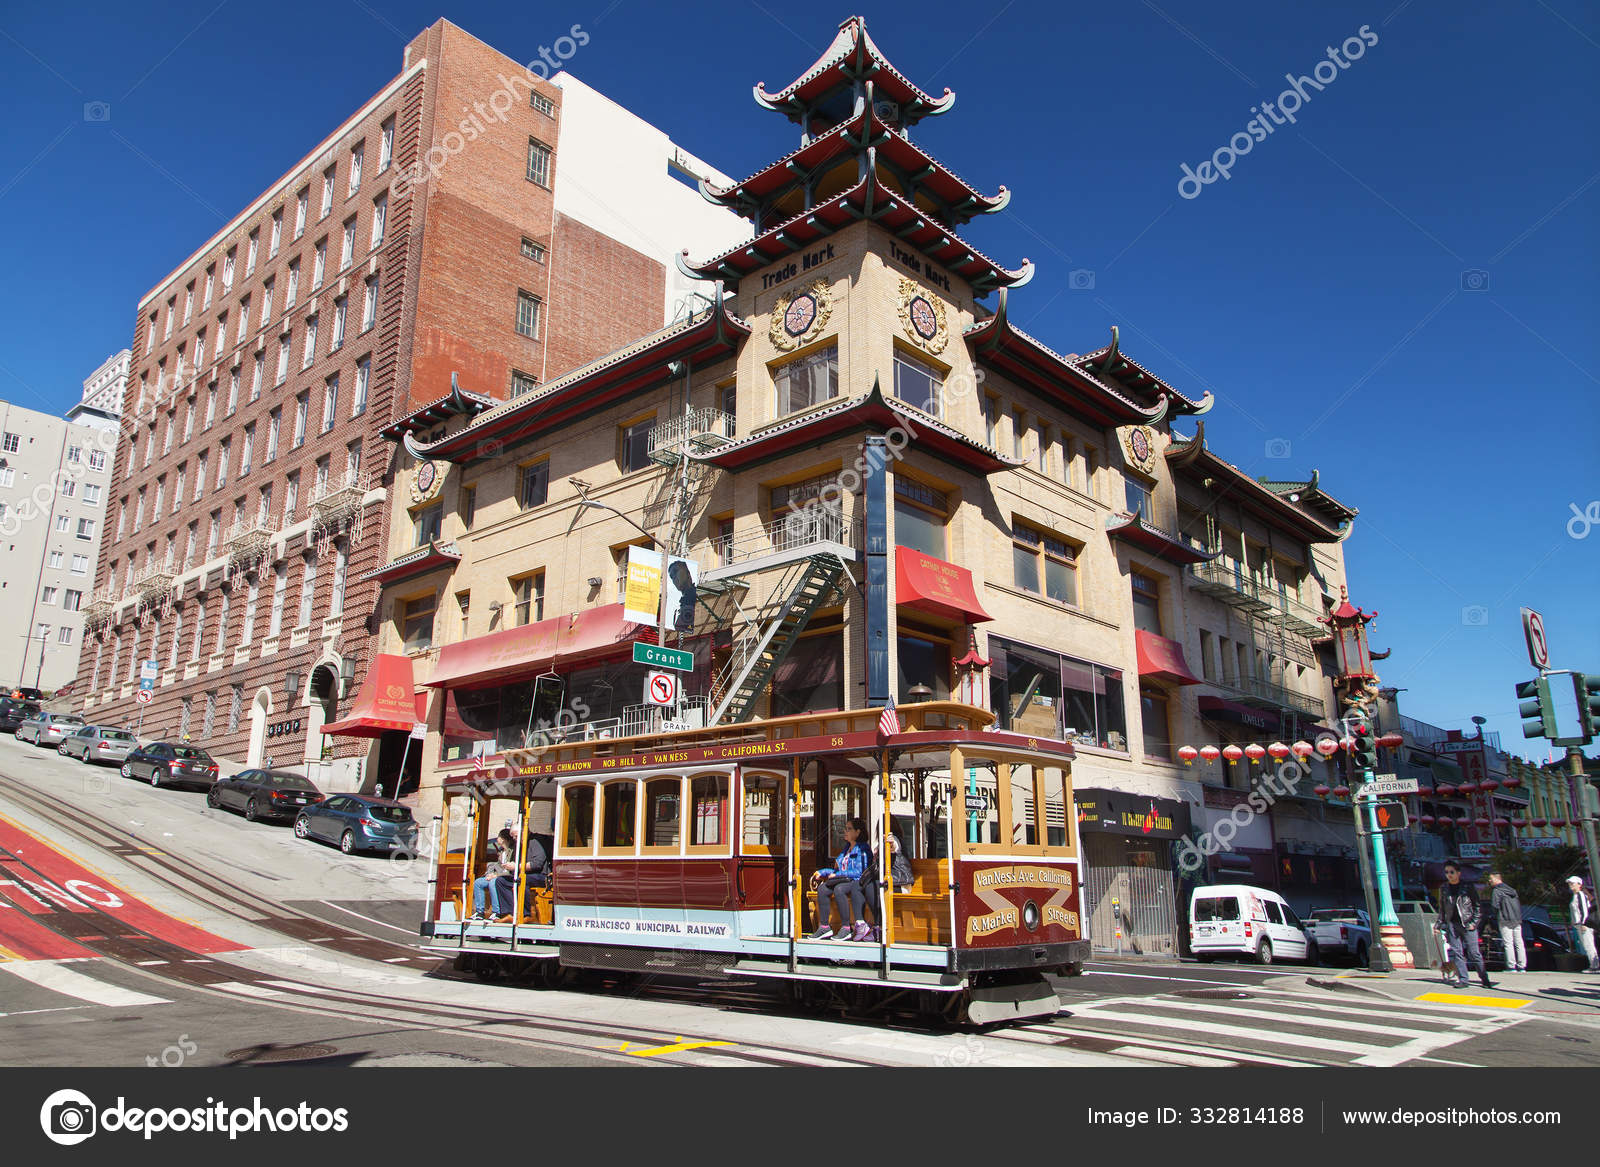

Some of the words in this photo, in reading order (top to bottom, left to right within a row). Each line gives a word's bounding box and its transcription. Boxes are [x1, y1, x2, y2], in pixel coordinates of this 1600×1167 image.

[761, 262, 797, 290] Trade
[802, 244, 835, 271] Mark
[889, 240, 921, 273] Trade
[925, 264, 950, 292] Mark
[646, 649, 682, 665] Grant
[663, 722, 690, 731] GRANT
[519, 765, 541, 775] MARKET
[557, 761, 592, 772] CHINATOWN
[602, 759, 615, 768] NOB
[620, 757, 635, 767] HILL
[654, 753, 667, 763] VAN
[669, 752, 688, 762] NESS
[721, 744, 772, 757] CALIFORNIA
[1363, 782, 1412, 793] CALIFORNIA
[976, 873, 993, 887] Van
[993, 870, 1017, 885] Ness
[1038, 870, 1072, 887] California
[566, 919, 582, 928] SAN
[585, 920, 631, 930] FRANCISCO
[635, 923, 681, 933] MUNICIPAL
[686, 925, 727, 936] RAILWAY
[971, 918, 980, 932] &
[981, 910, 1016, 932] Market
[1047, 907, 1076, 925] Streets
